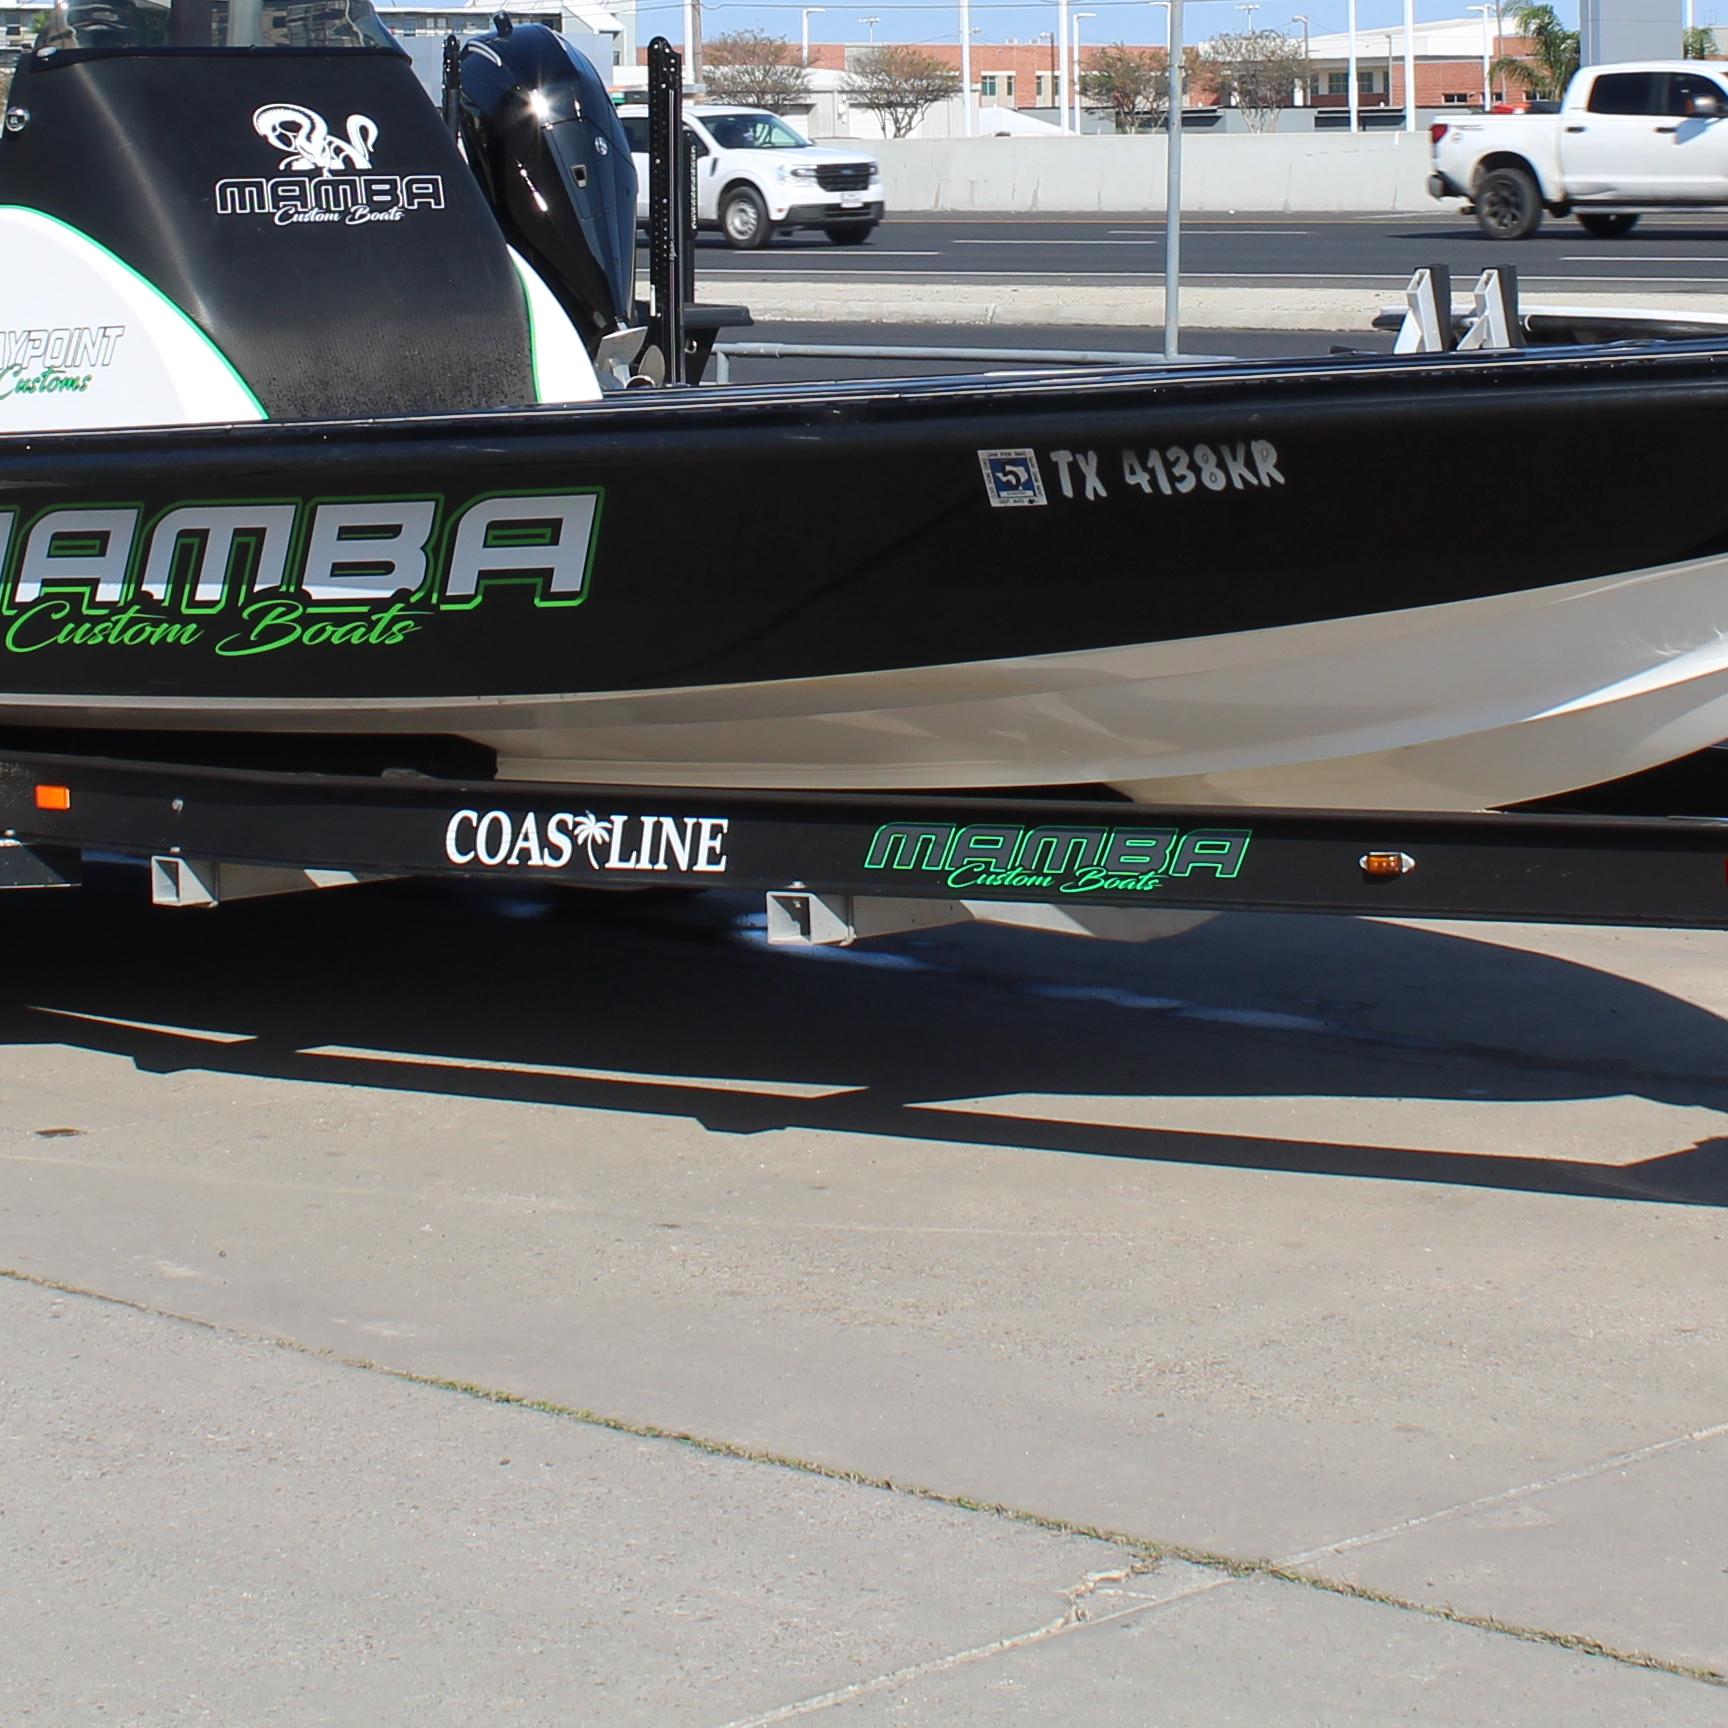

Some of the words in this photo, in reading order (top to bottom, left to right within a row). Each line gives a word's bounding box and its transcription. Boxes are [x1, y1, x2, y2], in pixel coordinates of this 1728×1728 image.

[215, 174, 446, 214] MAMBA
[274, 205, 342, 225] Custom
[345, 204, 405, 225] Boats
[1049, 449, 1108, 501] TX
[1122, 439, 1286, 496] 4138KR
[4, 597, 203, 654] Custom
[215, 597, 432, 658] Boats
[864, 821, 1253, 879] MAMBA
[946, 862, 1055, 890] Custom
[1059, 865, 1163, 894] Boats
